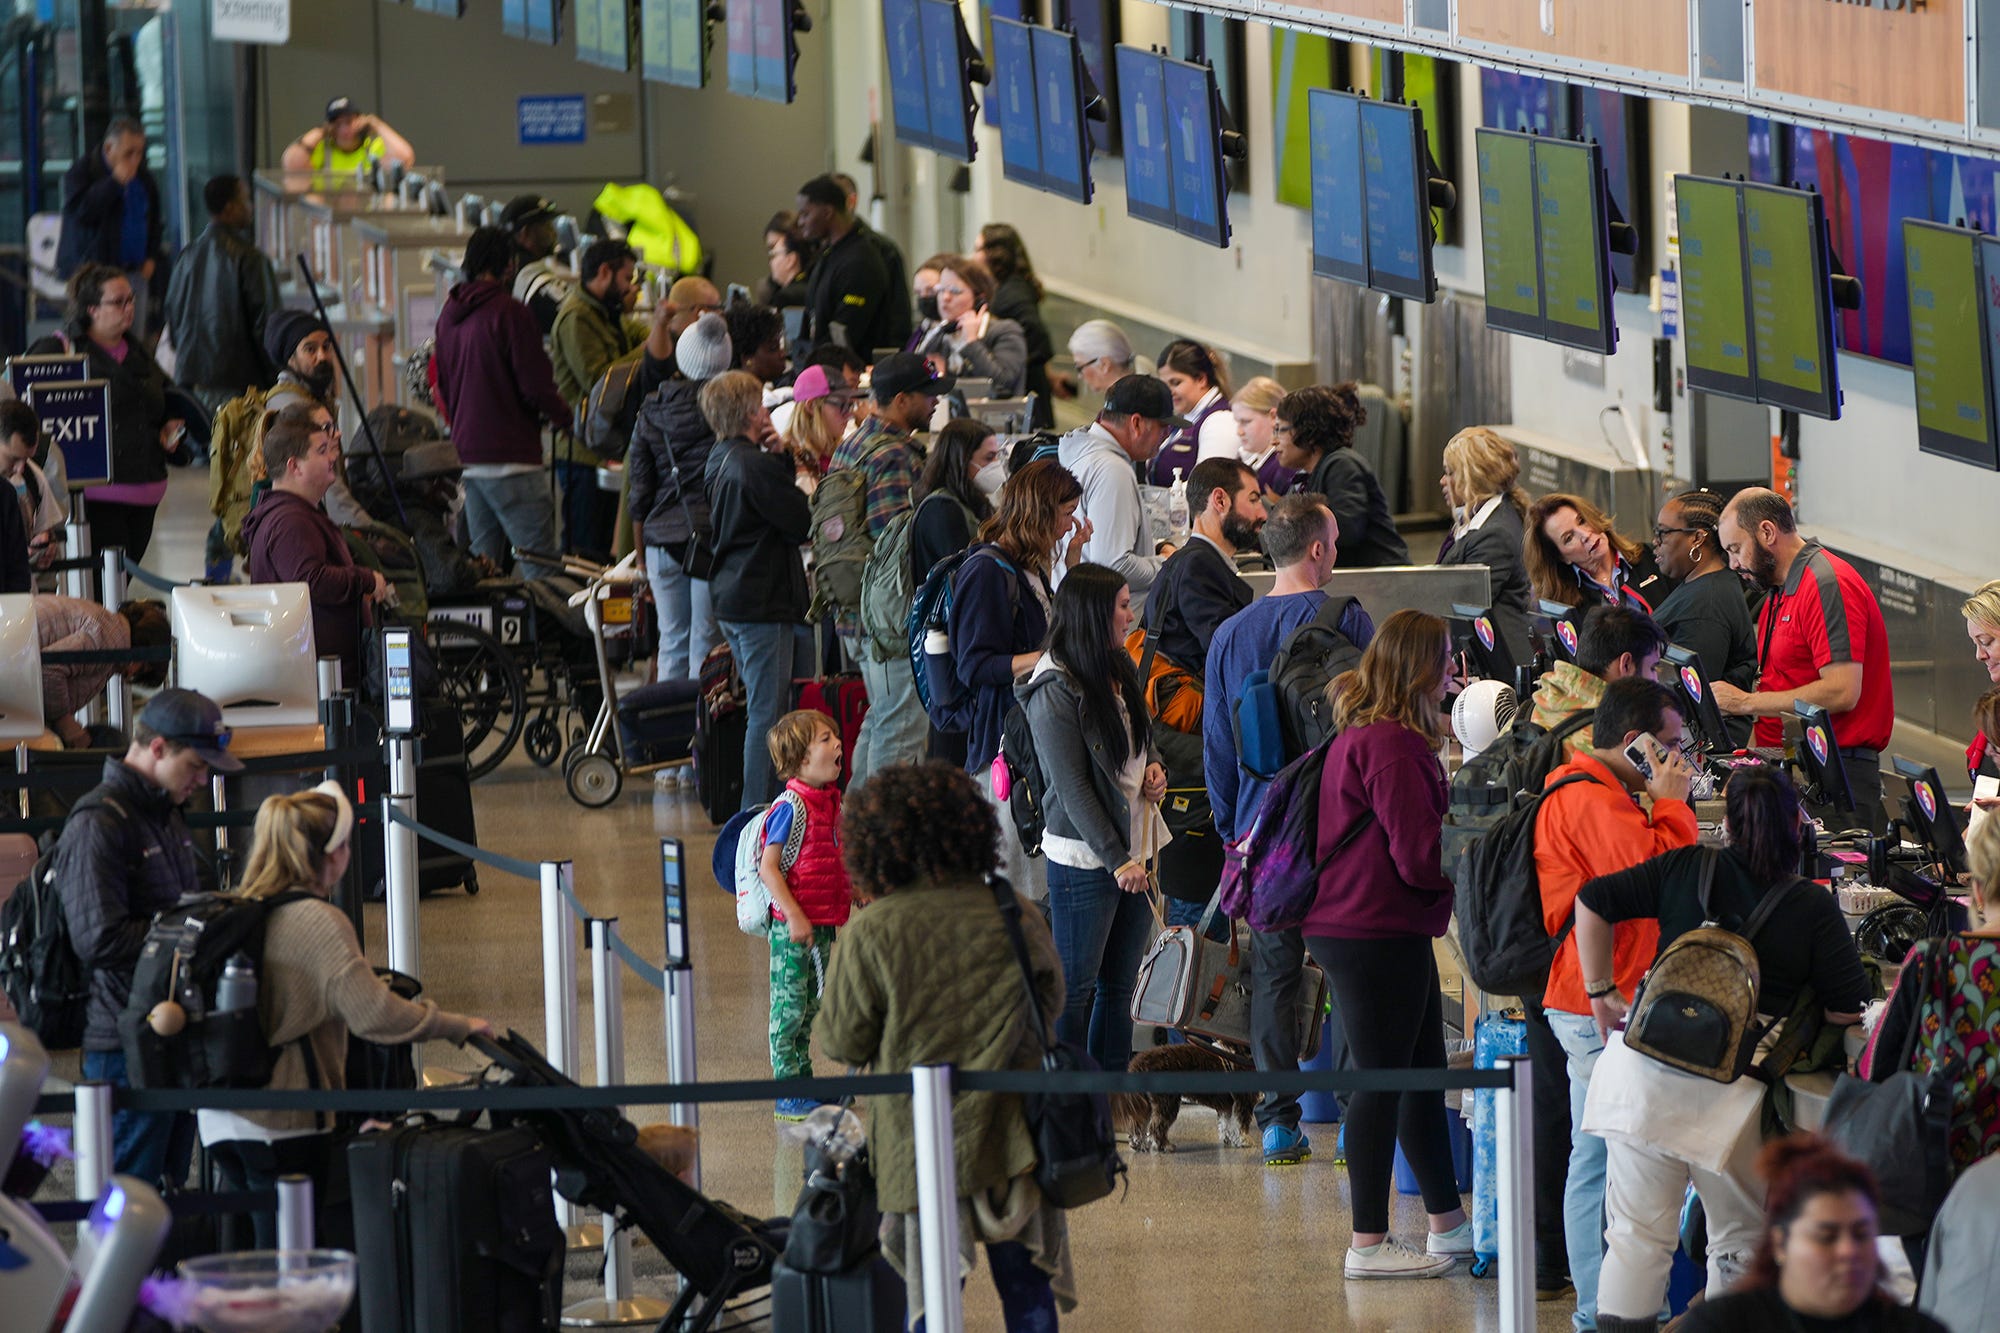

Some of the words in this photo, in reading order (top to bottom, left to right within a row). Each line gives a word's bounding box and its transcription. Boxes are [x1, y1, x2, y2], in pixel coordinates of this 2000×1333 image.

[54, 391, 85, 402] DELTA
[41, 416, 98, 441] EXIT
[504, 619, 518, 641] 9
[1482, 625, 1490, 642] 1
[1564, 627, 1573, 646] 2
[1687, 674, 1697, 693] 3
[1814, 734, 1823, 751] 4
[1921, 790, 1931, 811] 5
